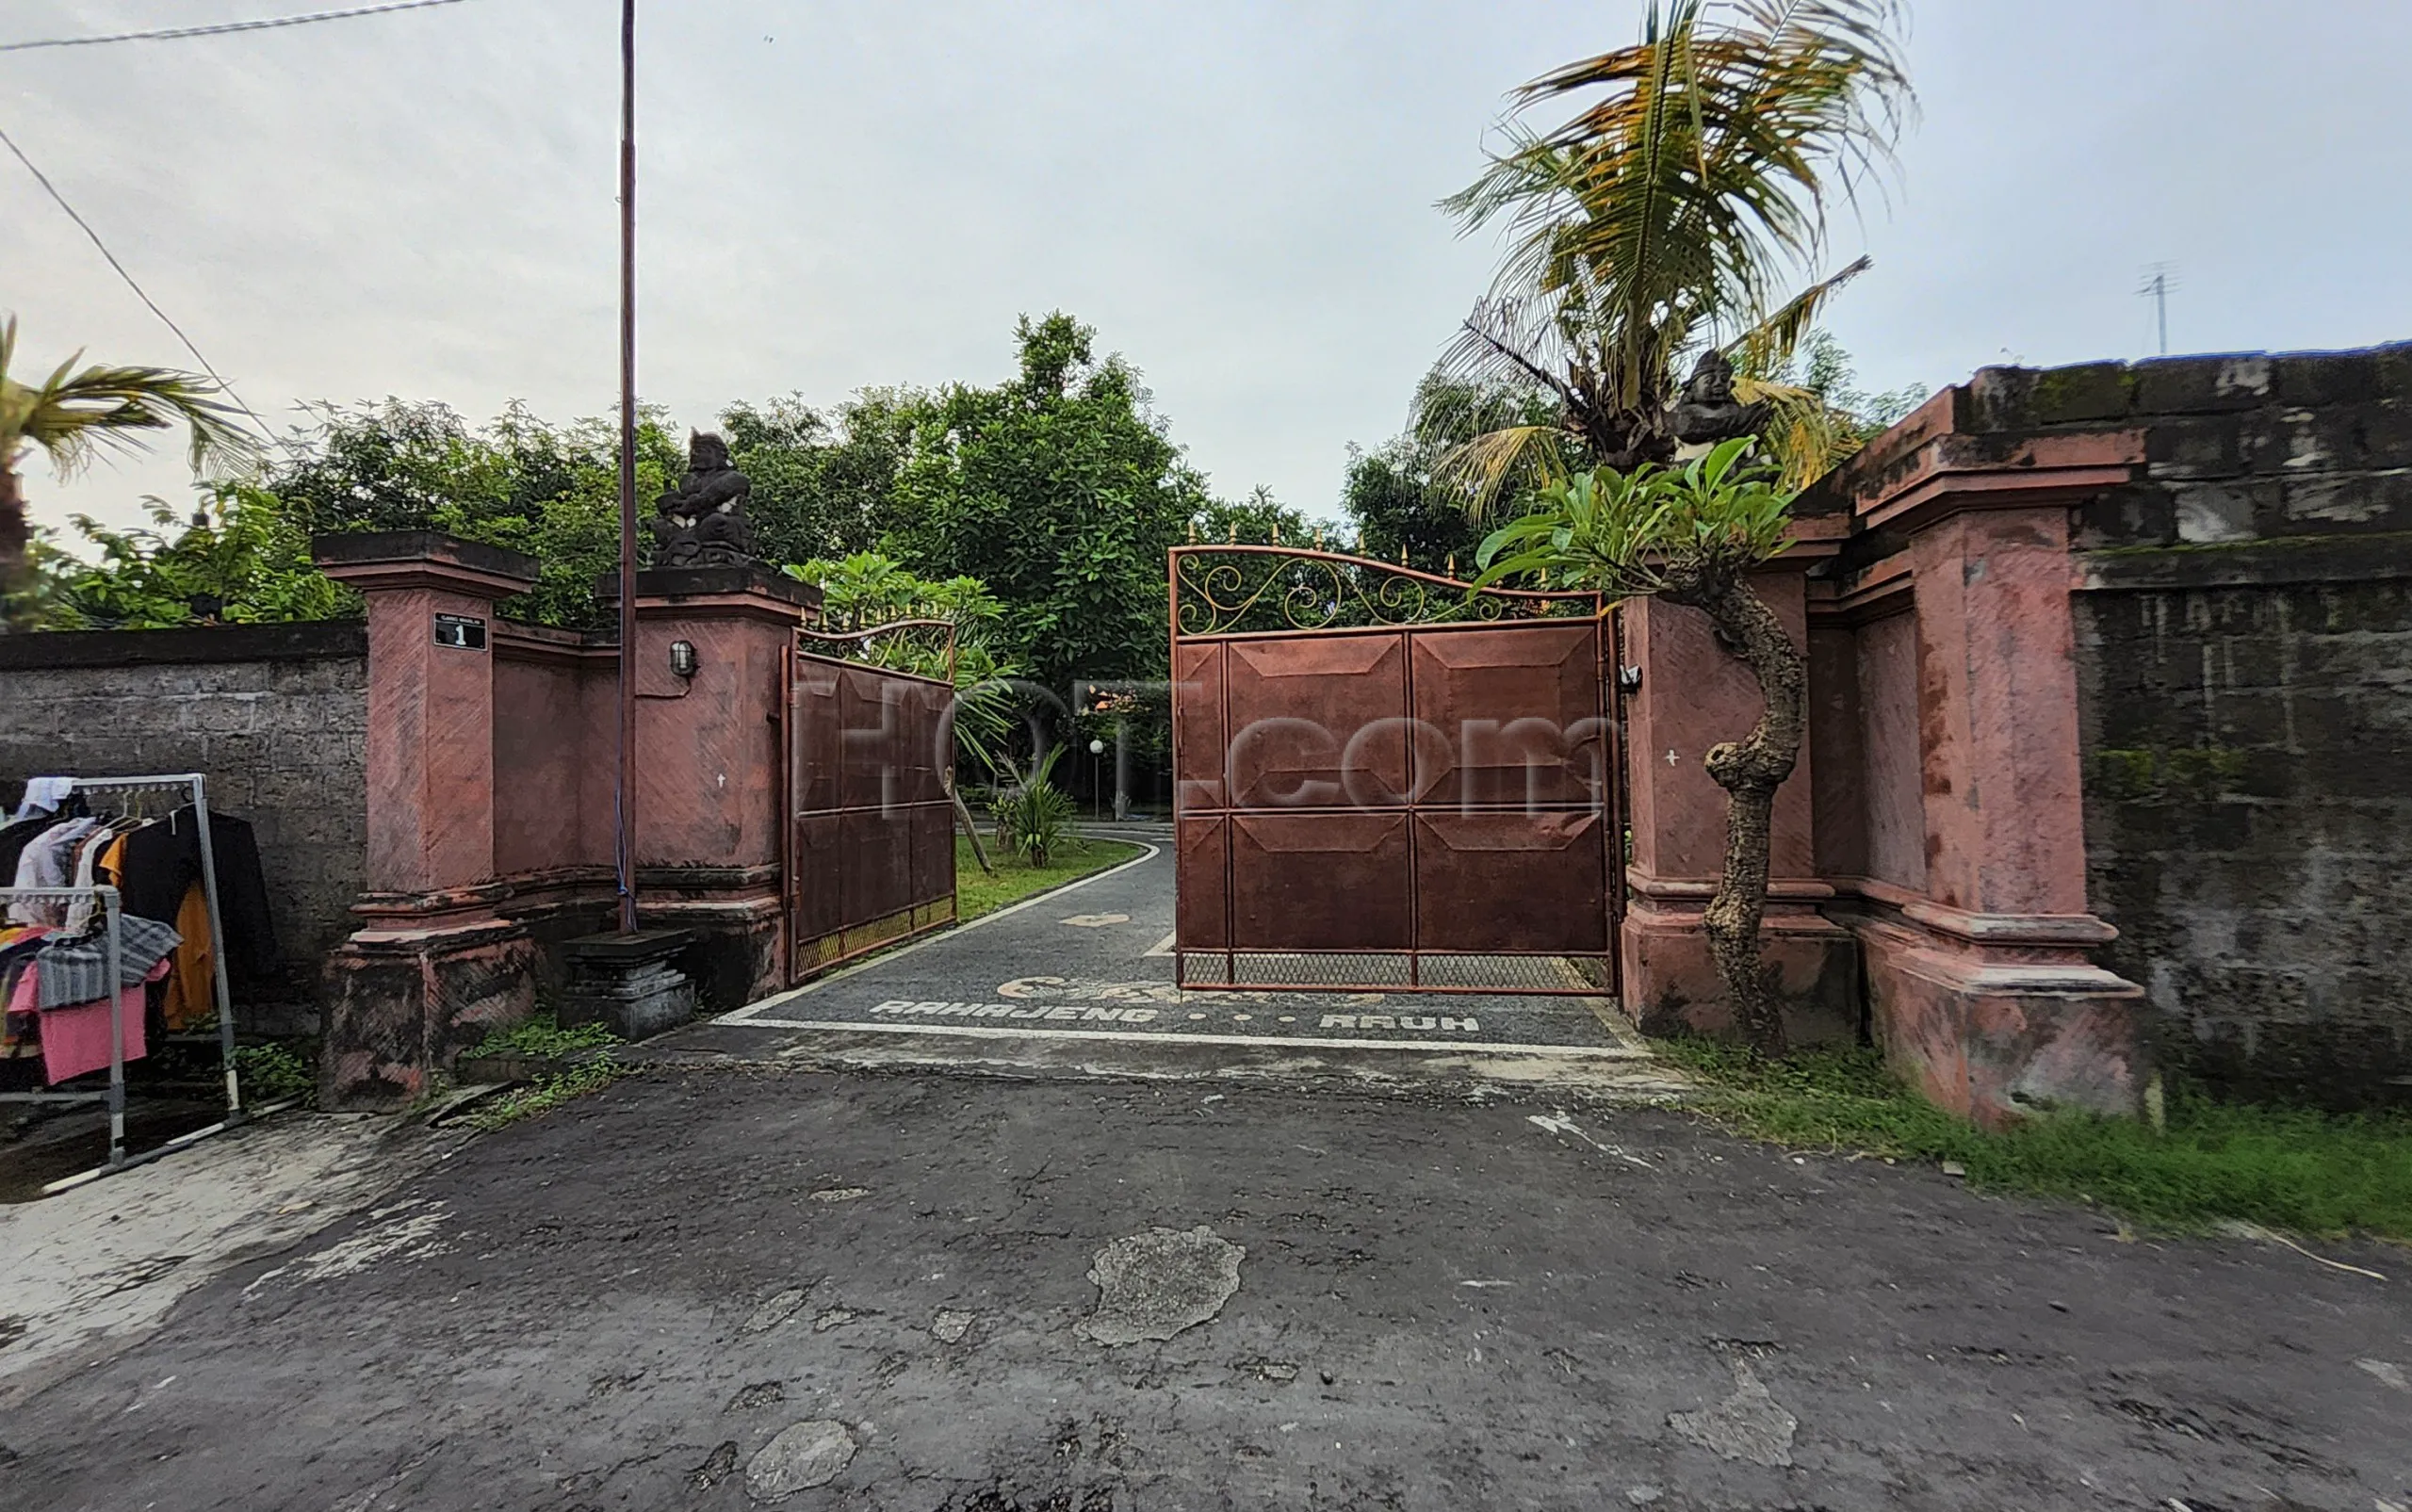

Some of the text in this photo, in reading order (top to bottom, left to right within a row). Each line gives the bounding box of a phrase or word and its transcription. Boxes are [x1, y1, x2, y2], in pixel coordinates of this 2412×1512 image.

[455, 625, 466, 645] 1
[869, 1000, 1159, 1023] RAHAJENG
[1319, 1014, 1479, 1032] RAUH
